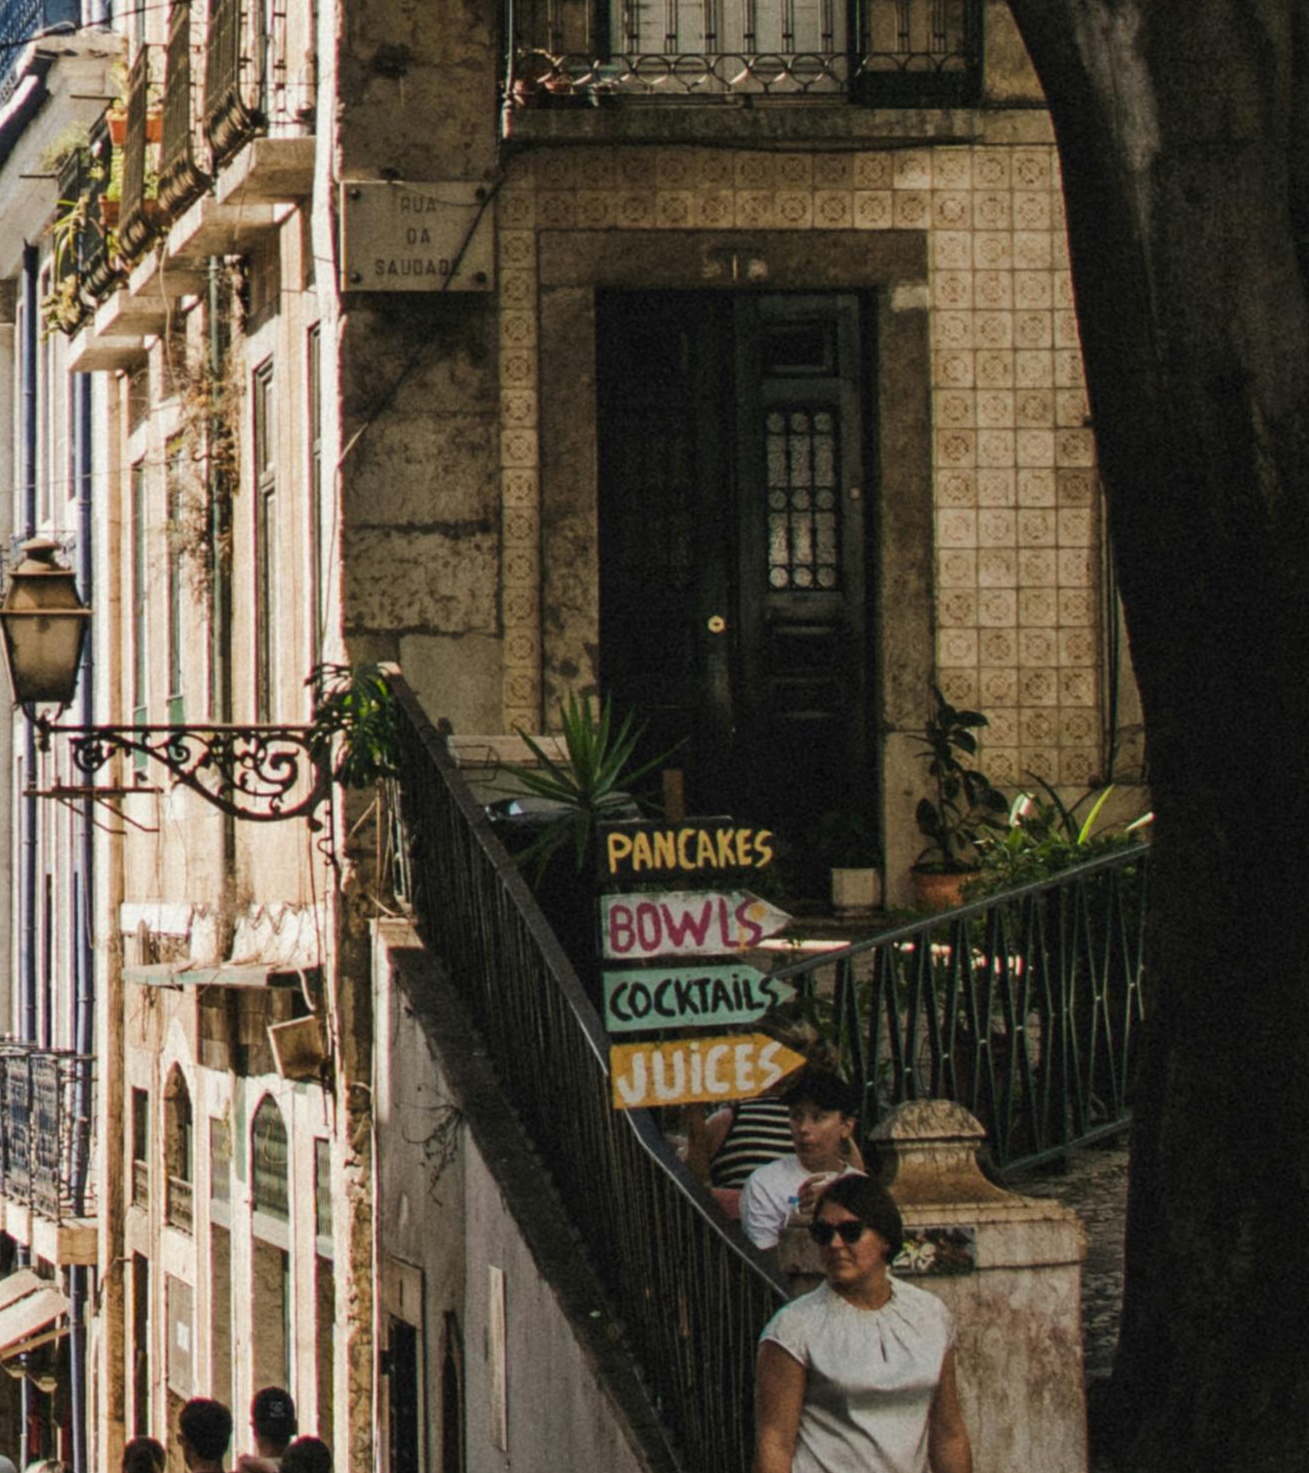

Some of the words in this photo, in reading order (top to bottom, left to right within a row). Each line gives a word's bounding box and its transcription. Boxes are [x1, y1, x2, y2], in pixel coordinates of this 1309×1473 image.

[400, 196, 437, 214] RUA
[607, 828, 774, 874] PANCAKES
[608, 895, 764, 954] BOWLS
